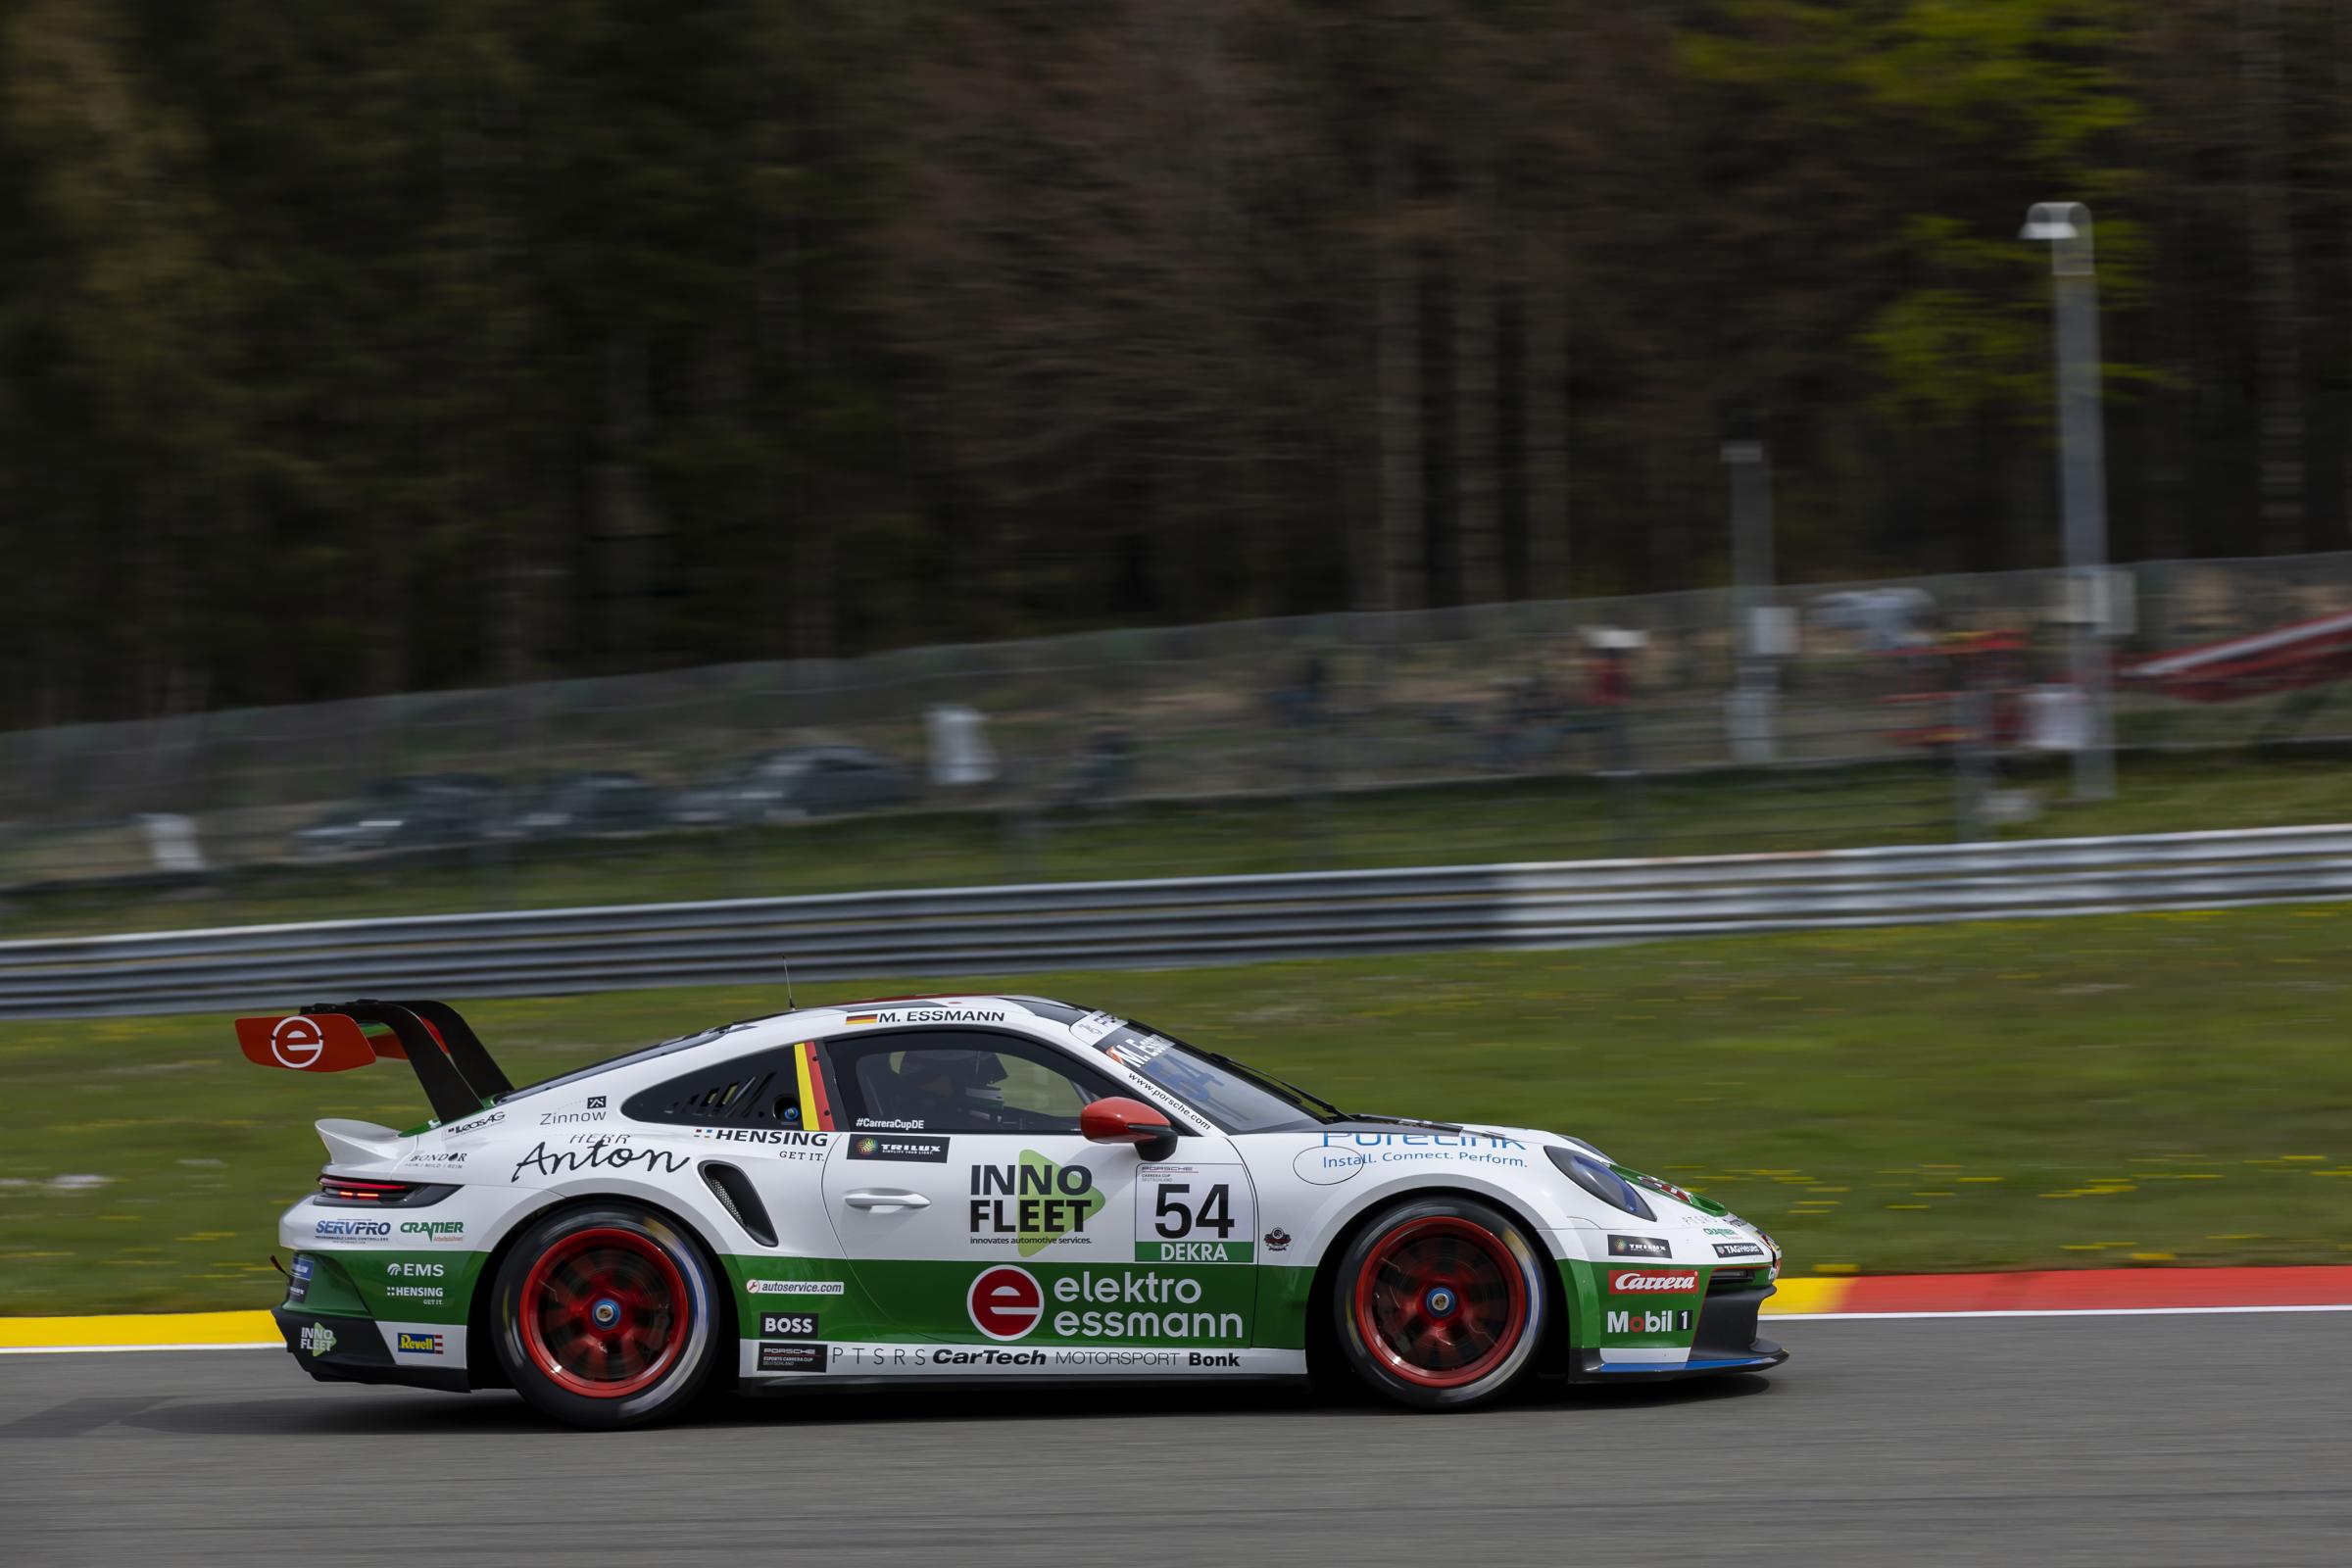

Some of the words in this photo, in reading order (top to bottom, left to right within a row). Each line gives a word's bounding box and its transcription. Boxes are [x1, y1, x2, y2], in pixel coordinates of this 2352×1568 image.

[879, 1012, 901, 1022] M.
[906, 1010, 1004, 1022] ESSMANN
[1128, 1072, 1211, 1130] www.porsche.com
[539, 1111, 607, 1126] Zinnow
[856, 1118, 925, 1131] #CarreraCupDE
[715, 1129, 829, 1147] HENSING
[779, 1151, 807, 1160] GET
[880, 1144, 941, 1152] TRILUX
[511, 1141, 691, 1183] Anton
[1323, 1154, 1377, 1168] Install.
[1383, 1152, 1453, 1162] Connect.
[1459, 1152, 1528, 1168] Perform.
[970, 1164, 1093, 1196] INNO
[970, 1200, 1092, 1232] FLEET
[1154, 1183, 1235, 1239] 54
[316, 1219, 391, 1236] SERVPRO
[400, 1221, 465, 1243] CRAMER
[970, 1236, 1009, 1245] innovates
[1010, 1235, 1057, 1245] automotive
[1057, 1236, 1092, 1245] services.
[1160, 1243, 1229, 1261] DEKRA
[404, 1263, 445, 1277] EMS
[761, 1282, 842, 1293] autoservice.com
[1054, 1271, 1201, 1304] elektro
[1615, 1273, 1695, 1291] Carrera
[396, 1287, 443, 1297] HENSING
[764, 1317, 813, 1334] BOSS
[1054, 1311, 1244, 1339] essmann
[1607, 1310, 1673, 1333] Mobil
[1681, 1311, 1688, 1330] 1
[301, 1327, 333, 1340] INNO
[300, 1339, 332, 1351] FLEET
[401, 1334, 433, 1350] Revell
[932, 1348, 1047, 1366] CarTech
[1055, 1350, 1180, 1366] MOTORSPORT
[1189, 1352, 1240, 1367] Bonk
